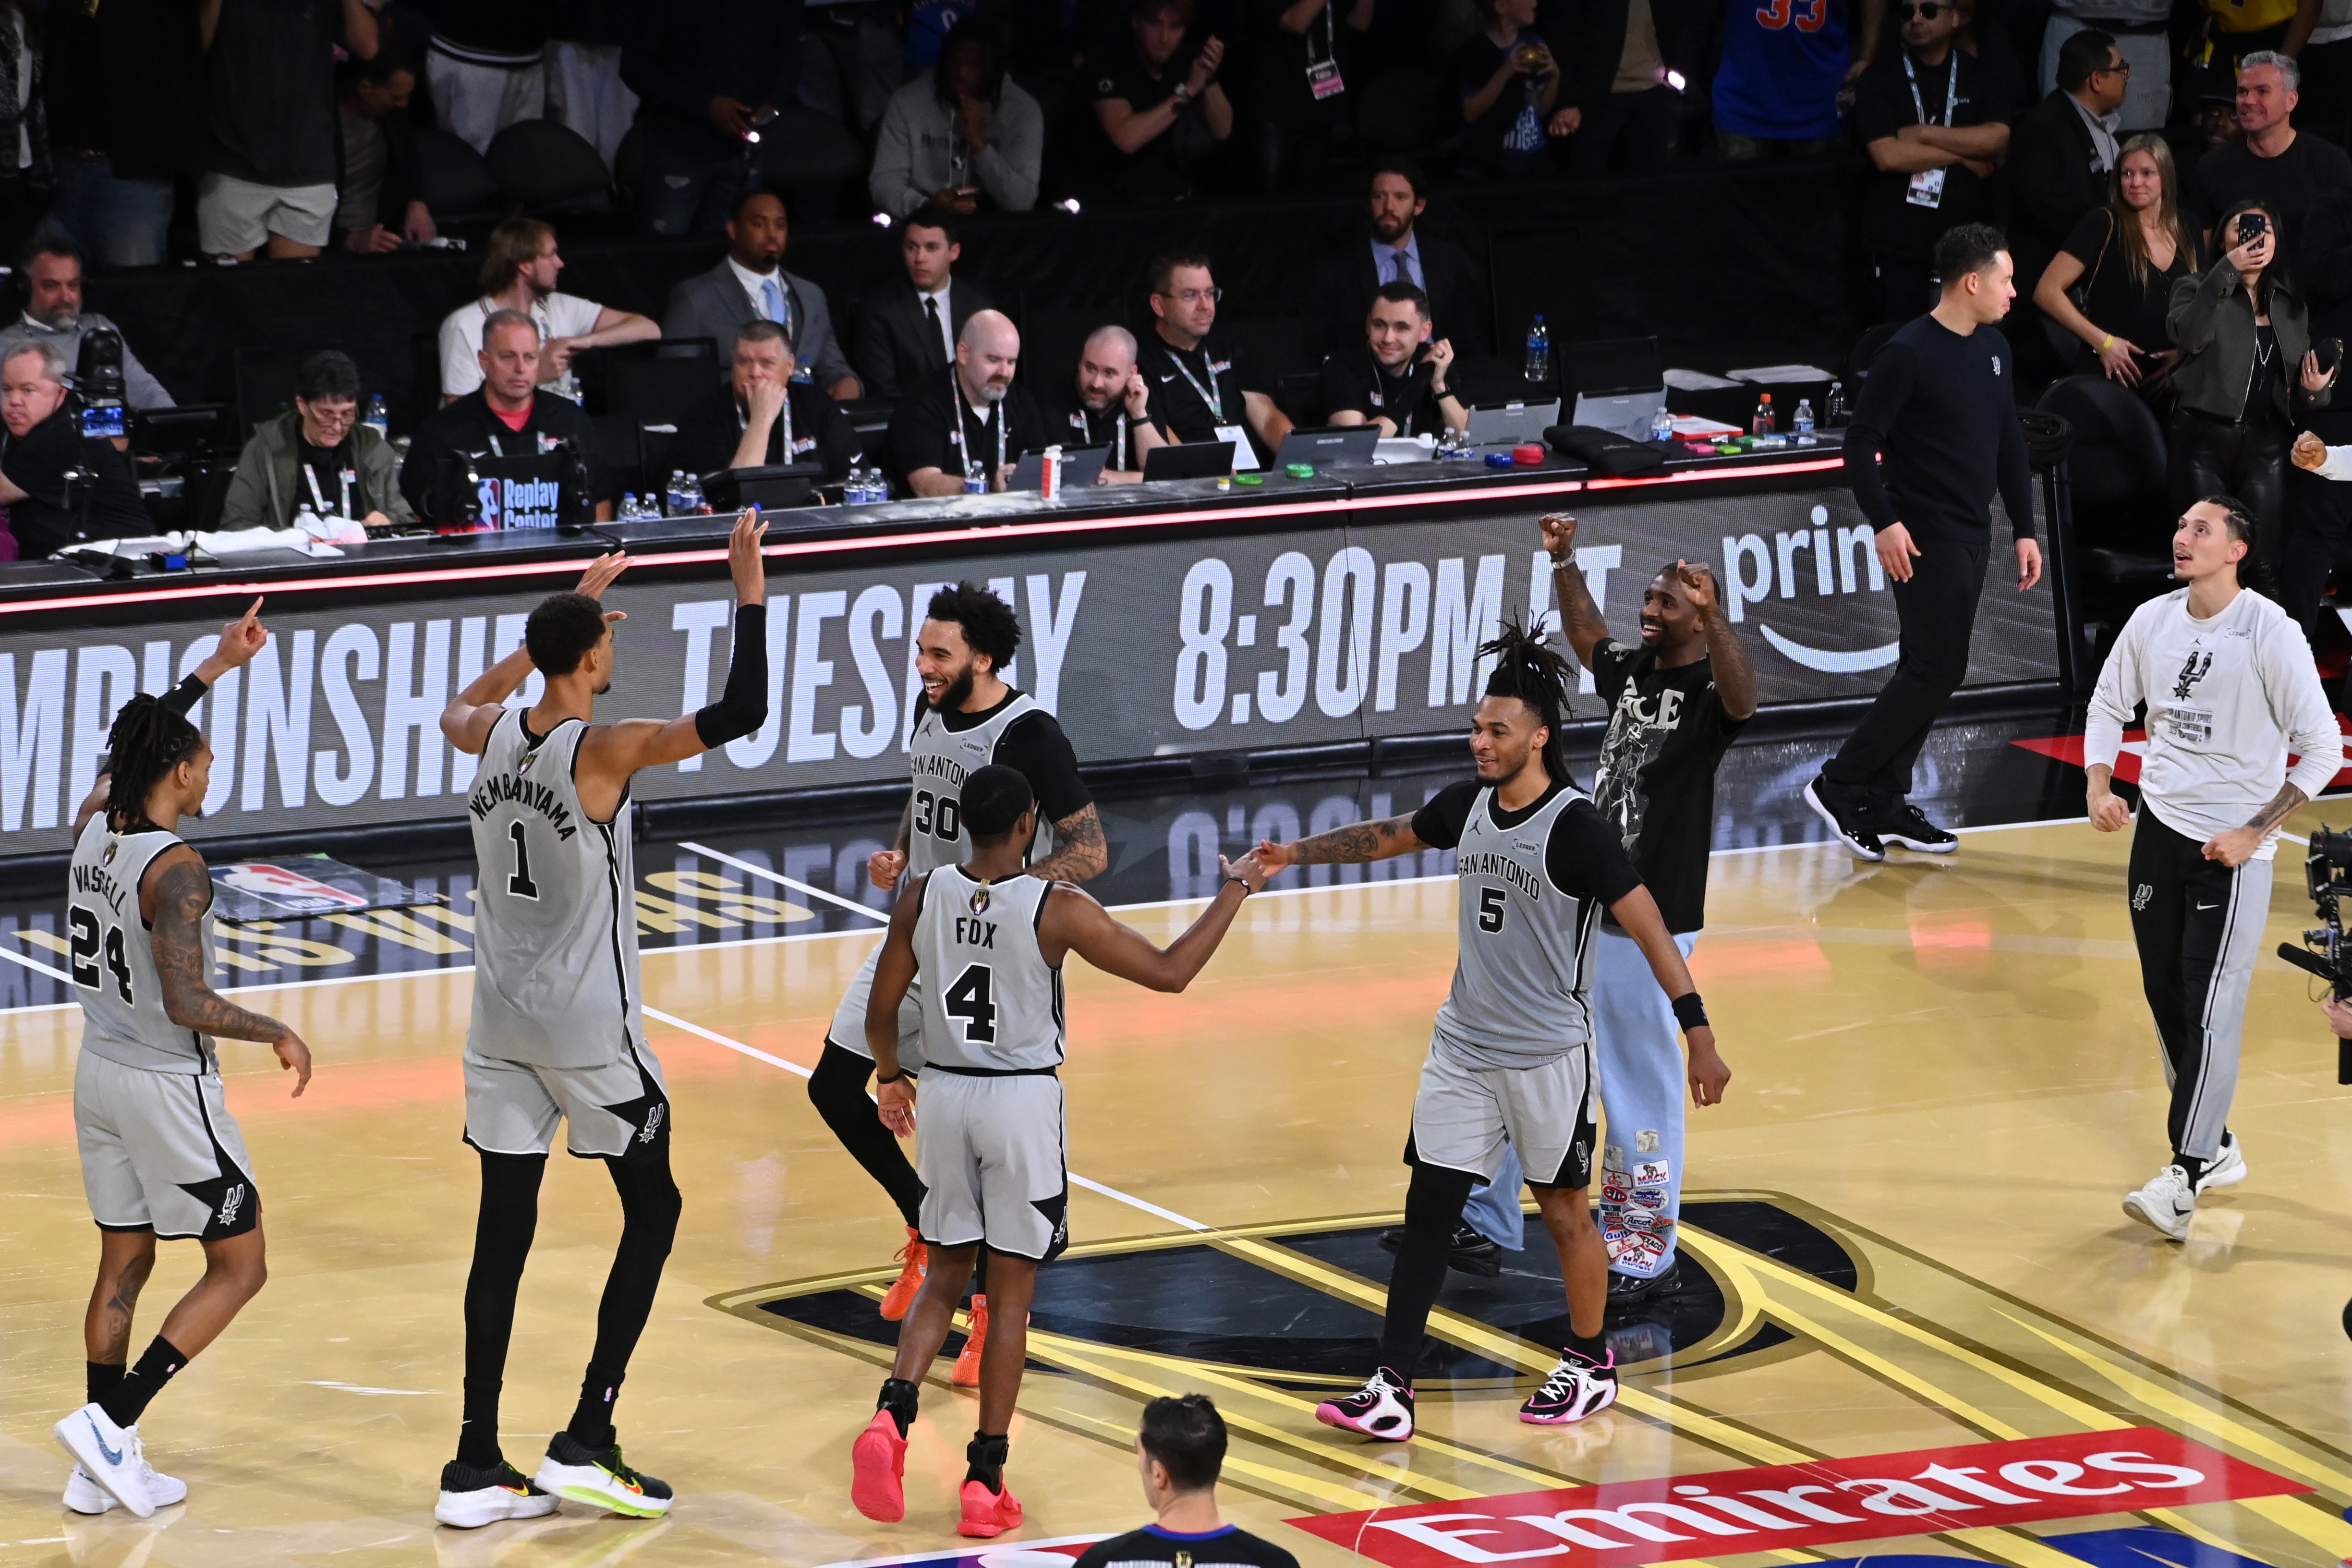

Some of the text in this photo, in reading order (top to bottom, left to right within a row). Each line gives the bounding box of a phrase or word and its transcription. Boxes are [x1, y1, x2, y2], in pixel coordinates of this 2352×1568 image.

[1756, 0, 1826, 32] 33
[504, 477, 558, 513] Replay
[1173, 547, 1505, 730] 8:30PM
[964, 741, 983, 753] LEDGER
[470, 773, 577, 842] WEMBANYAMA
[914, 788, 960, 843] 30
[507, 818, 539, 901] 1
[1516, 842, 1535, 851] LEDGER
[73, 864, 126, 918] VASSELL
[1479, 852, 1541, 902] ANTONIO
[1478, 886, 1507, 935] 5
[956, 917, 997, 949] FOX
[68, 902, 134, 1009] 24
[942, 961, 998, 1046] 4
[1605, 1189, 1625, 1200] STP
[1637, 1172, 1666, 1185] MACK
[1605, 1230, 1630, 1240] Gulf
[1625, 1215, 1652, 1226] Ascot
[1652, 1222, 1674, 1231] STANDARD
[1641, 1236, 1663, 1251] EXACO
[1622, 1255, 1654, 1272] MACK
[1366, 1450, 2206, 1563] Emirates
